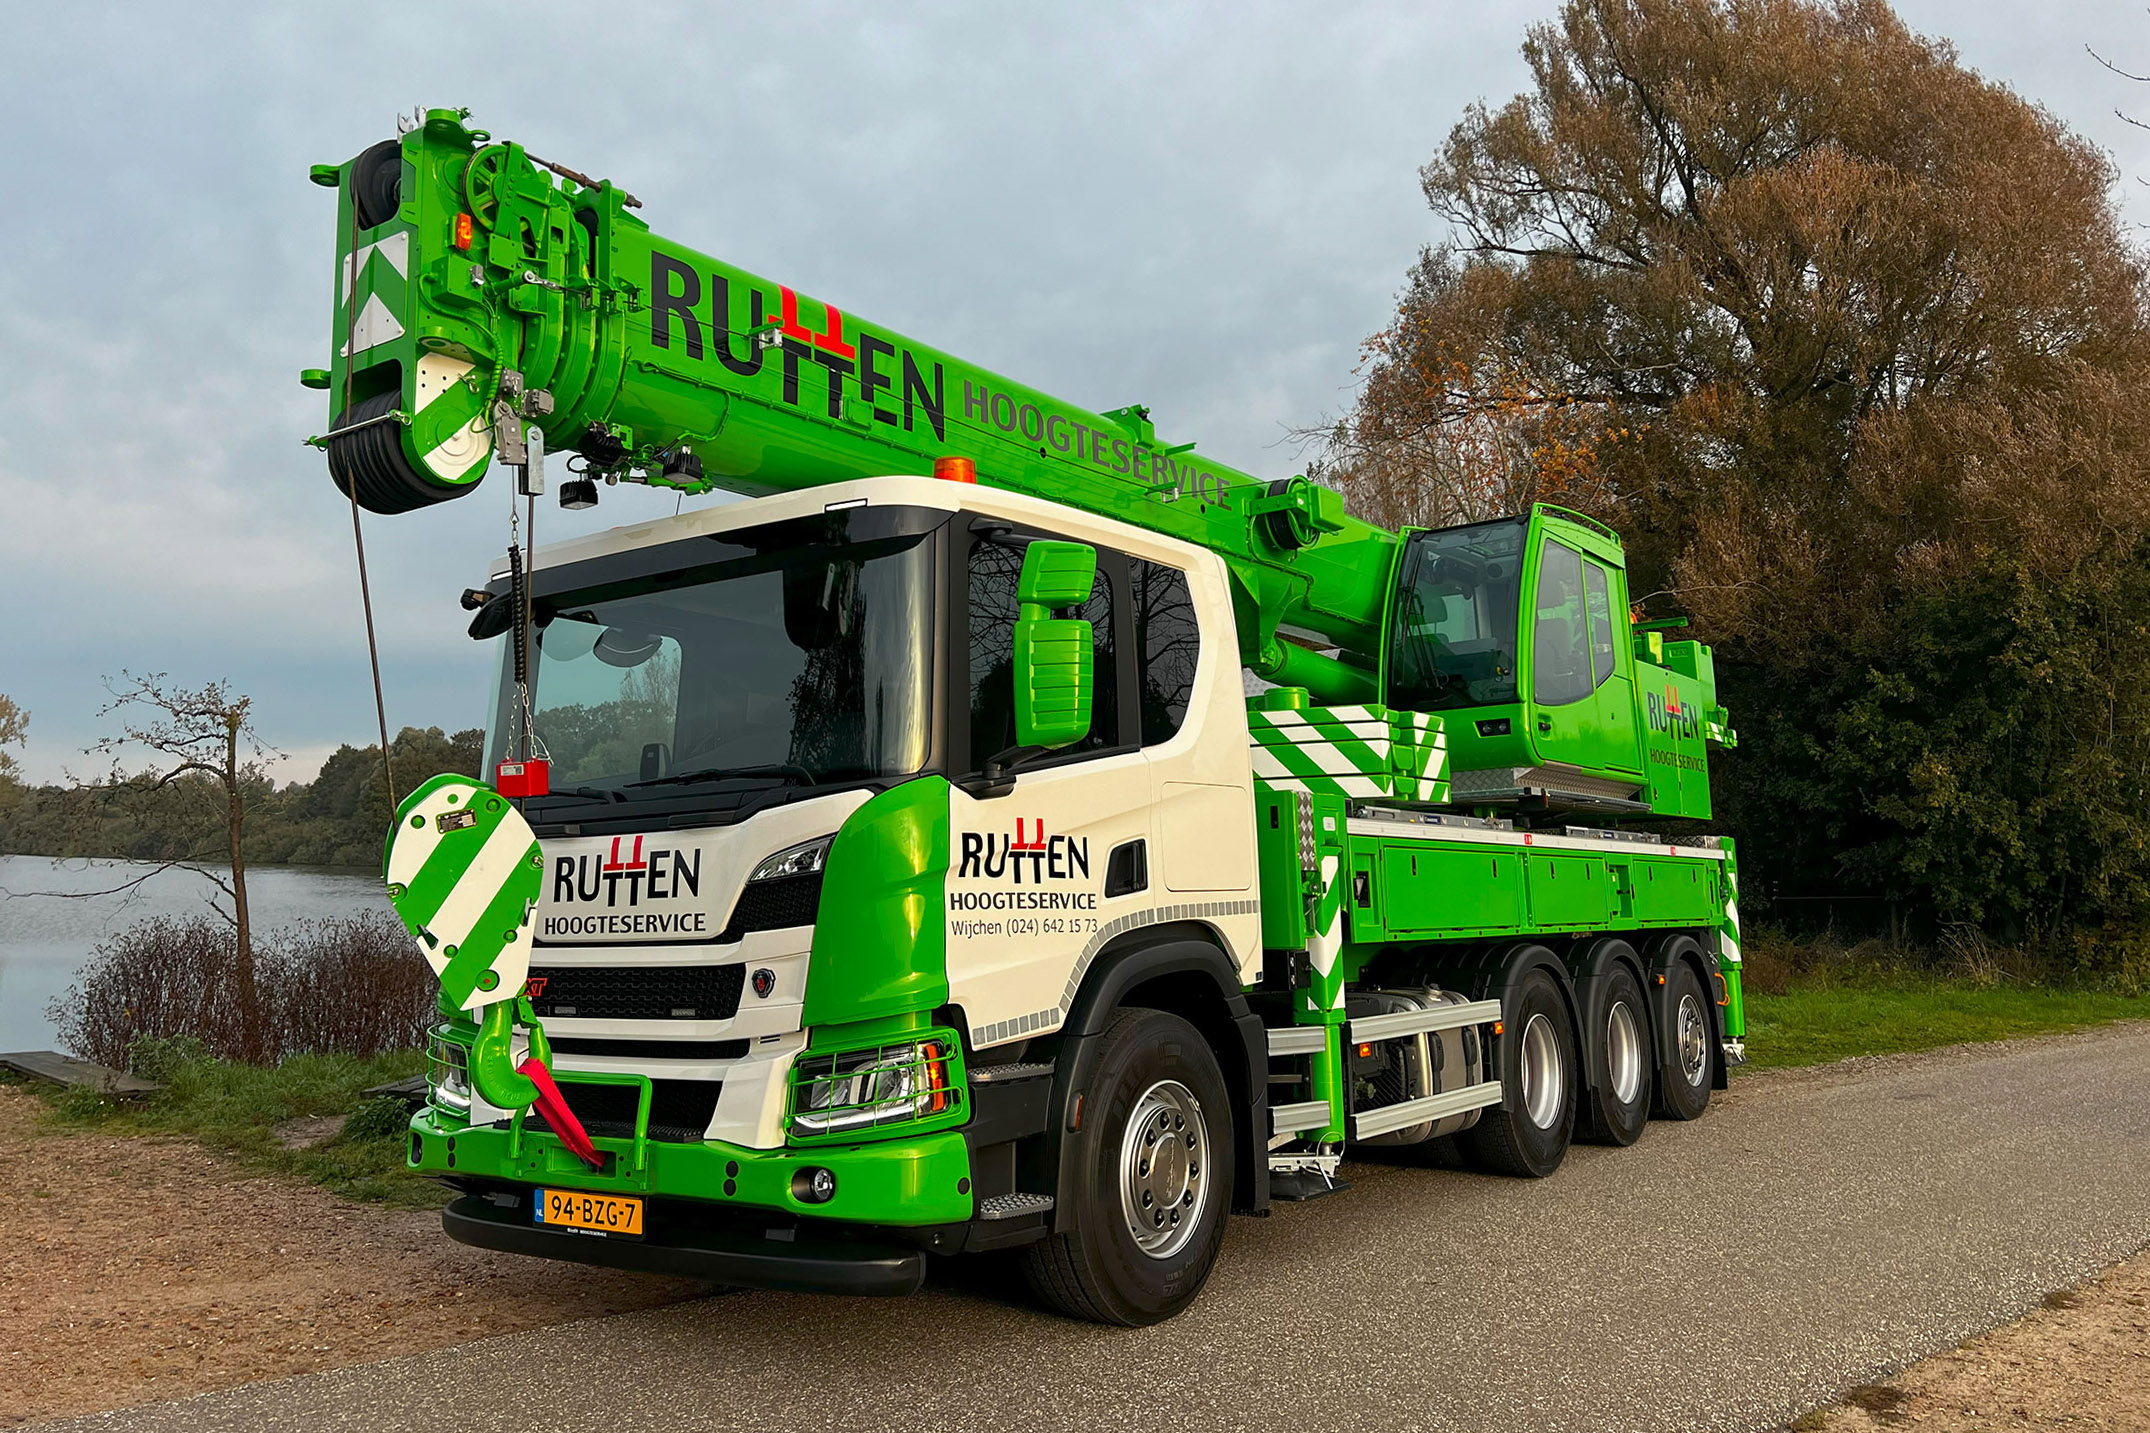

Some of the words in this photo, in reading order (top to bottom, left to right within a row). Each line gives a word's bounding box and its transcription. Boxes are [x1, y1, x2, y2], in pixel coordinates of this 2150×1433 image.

[651, 250, 945, 443] RUTTEN
[963, 379, 1232, 512] HOOGTESERVICE
[1647, 684, 1699, 741] RUTTEN
[1650, 748, 1705, 773] HOOGTESERVICE
[958, 817, 1089, 884] RUTTEN
[553, 835, 701, 907] RUTTEN
[950, 892, 1097, 911] HOOGTESERVICE
[544, 913, 706, 935] HOOGTESERVICE
[951, 920, 1002, 939] Wijchen
[1006, 917, 1039, 937] (024)
[1043, 918, 1065, 933] 642
[1068, 918, 1081, 933] 15
[1085, 917, 1098, 933] 73
[535, 1208, 544, 1217] NL
[551, 1195, 636, 1228] 94-BZG-7
